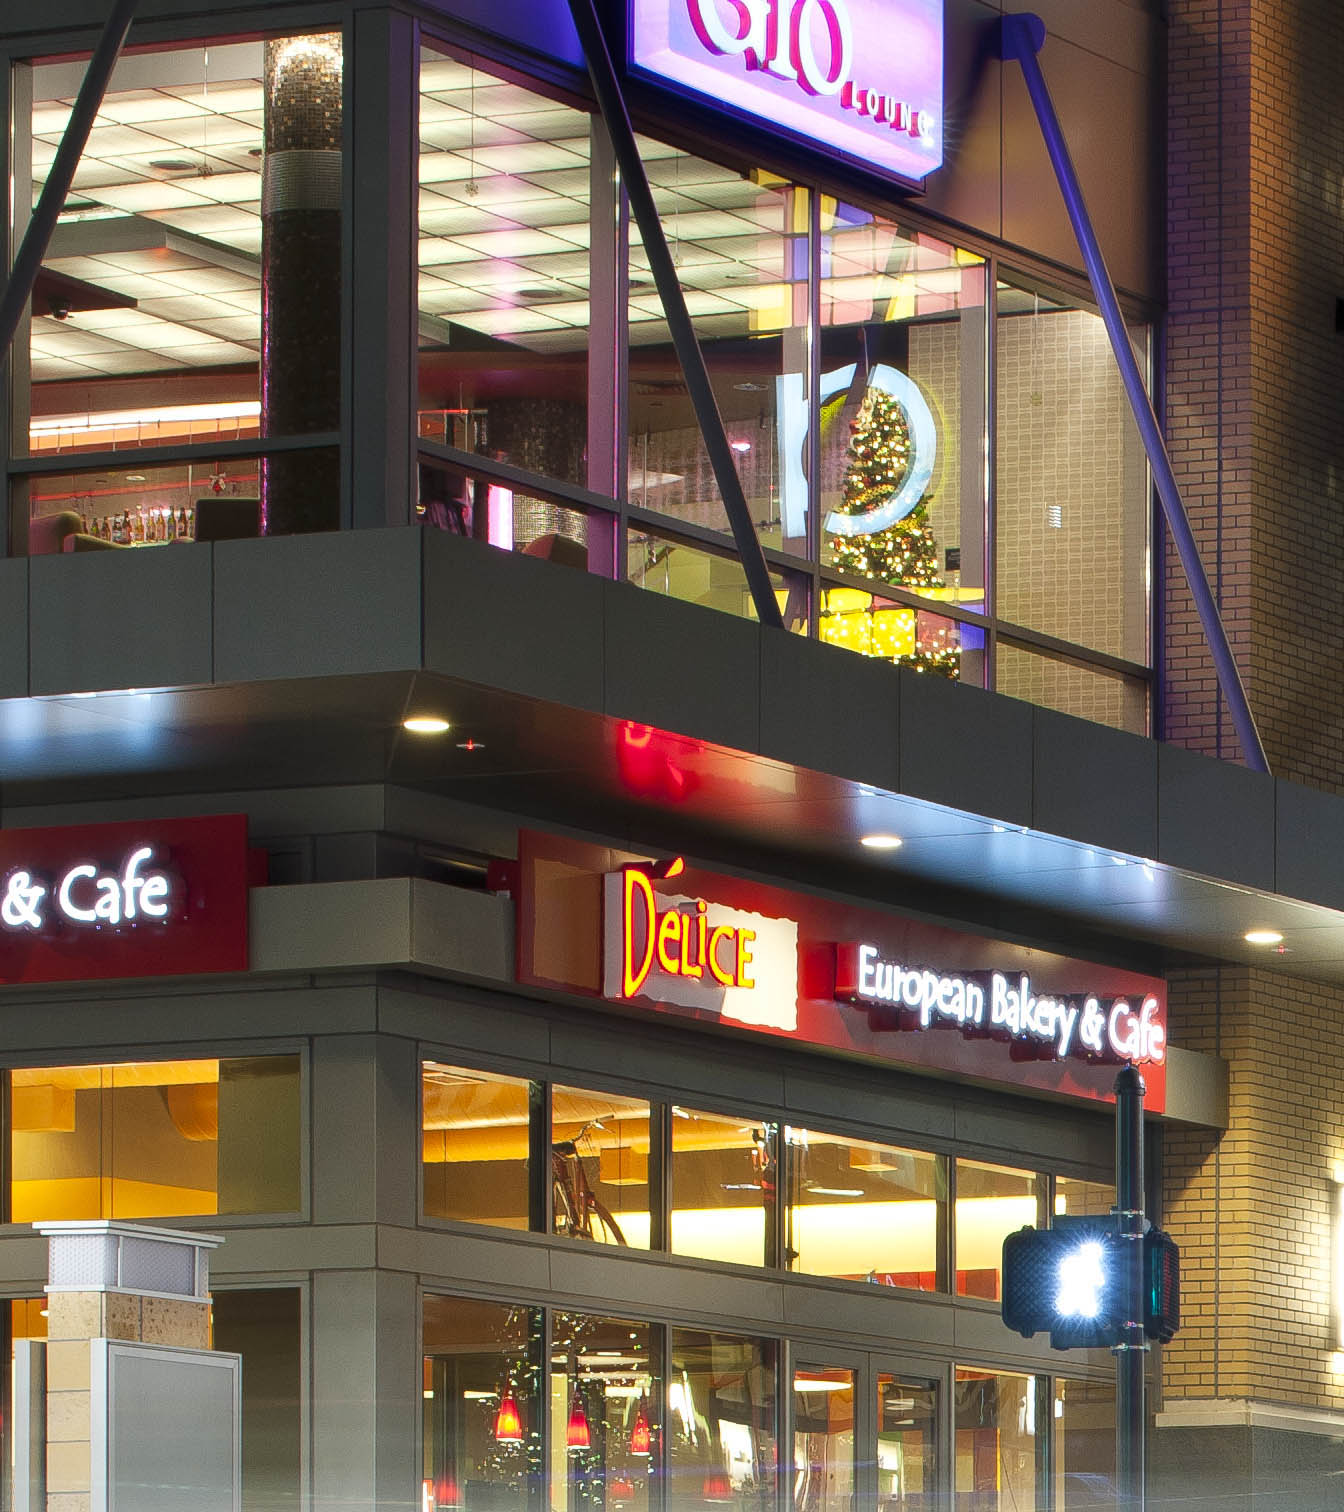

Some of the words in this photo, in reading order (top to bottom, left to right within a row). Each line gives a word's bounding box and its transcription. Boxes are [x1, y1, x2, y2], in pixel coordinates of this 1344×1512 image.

[1, 871, 46, 928] &
[59, 847, 168, 924] Cafe
[858, 943, 983, 1027] European
[991, 973, 1080, 1057] Bakery
[1080, 997, 1107, 1051] &
[1108, 998, 1166, 1061] Cafe
